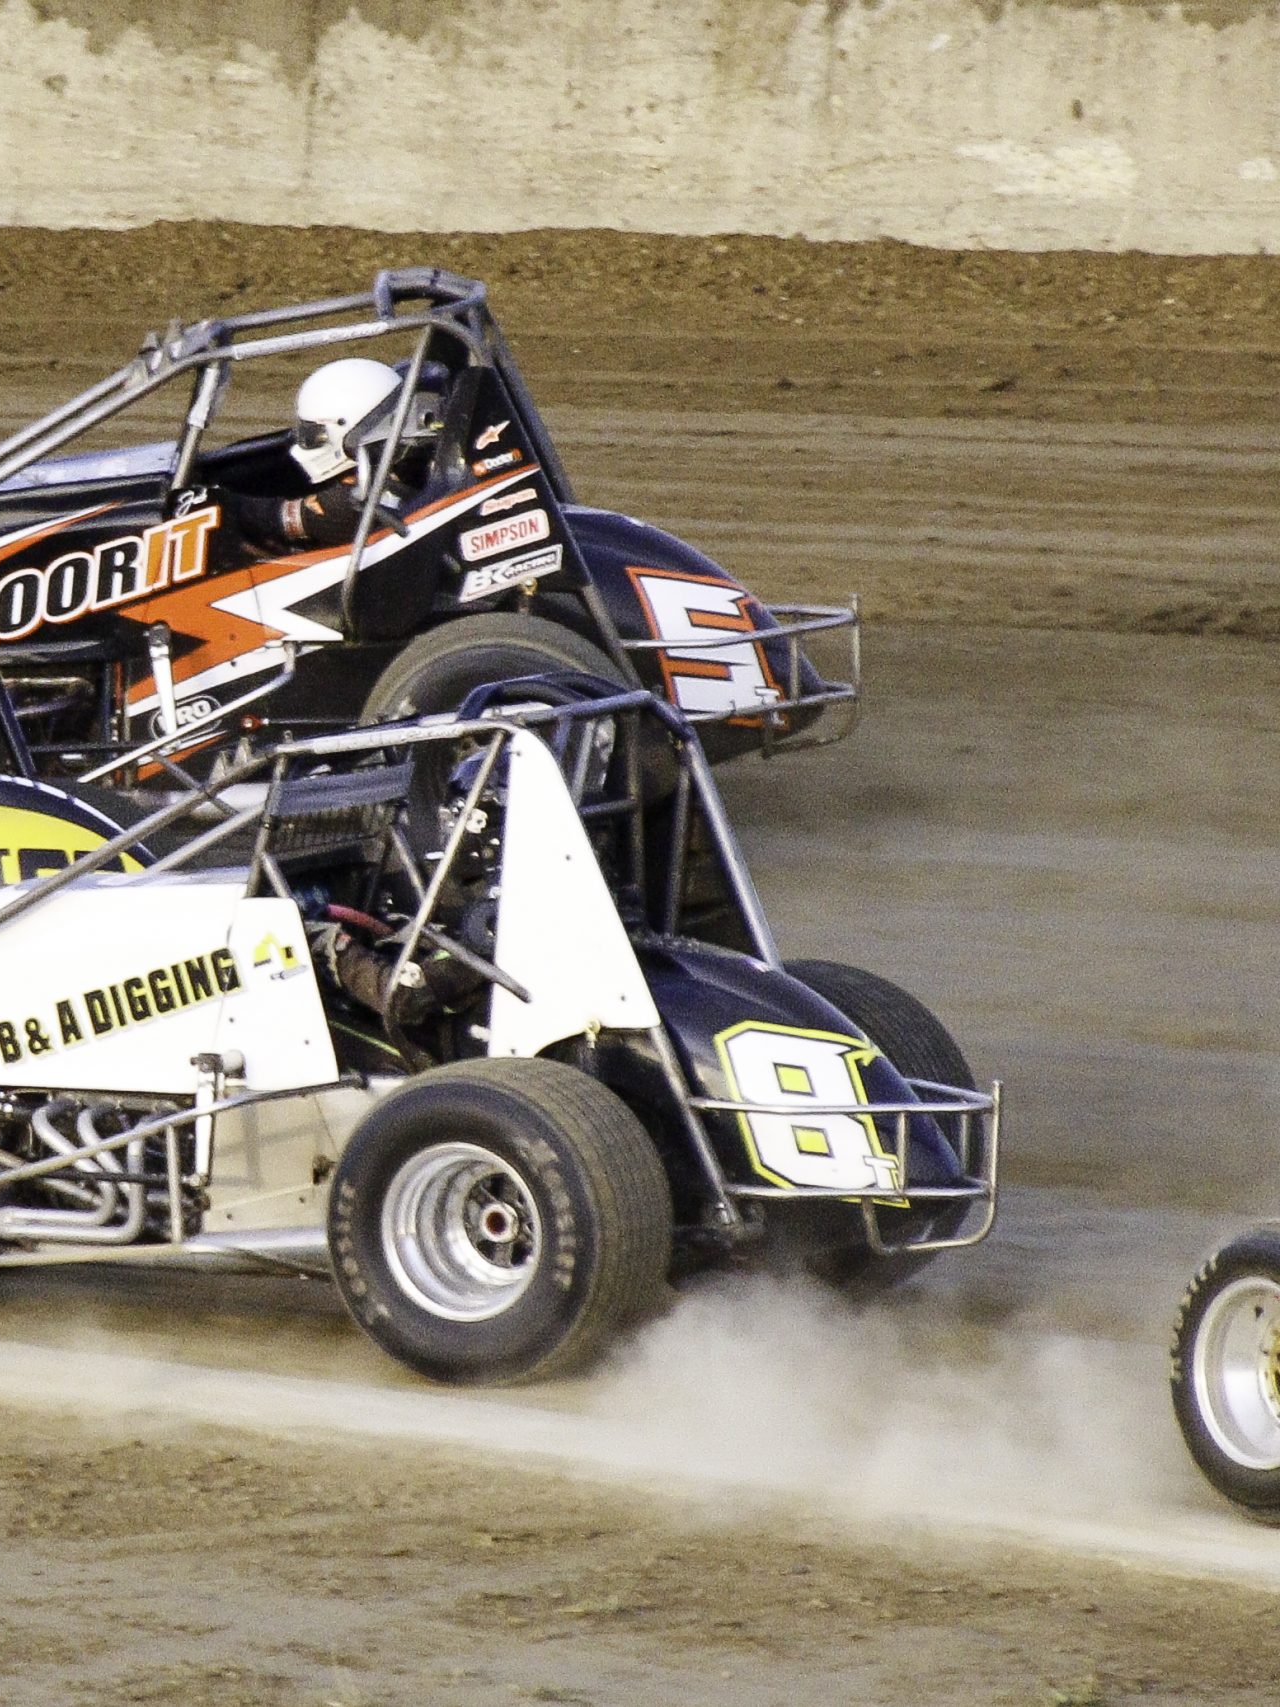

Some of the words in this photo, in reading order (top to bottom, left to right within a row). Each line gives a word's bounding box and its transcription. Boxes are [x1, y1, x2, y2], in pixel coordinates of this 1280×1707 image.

[470, 517, 540, 554] SIMPSON
[25, 1018, 52, 1055] &
[56, 1000, 84, 1045] A
[83, 948, 241, 1035] DIGGING
